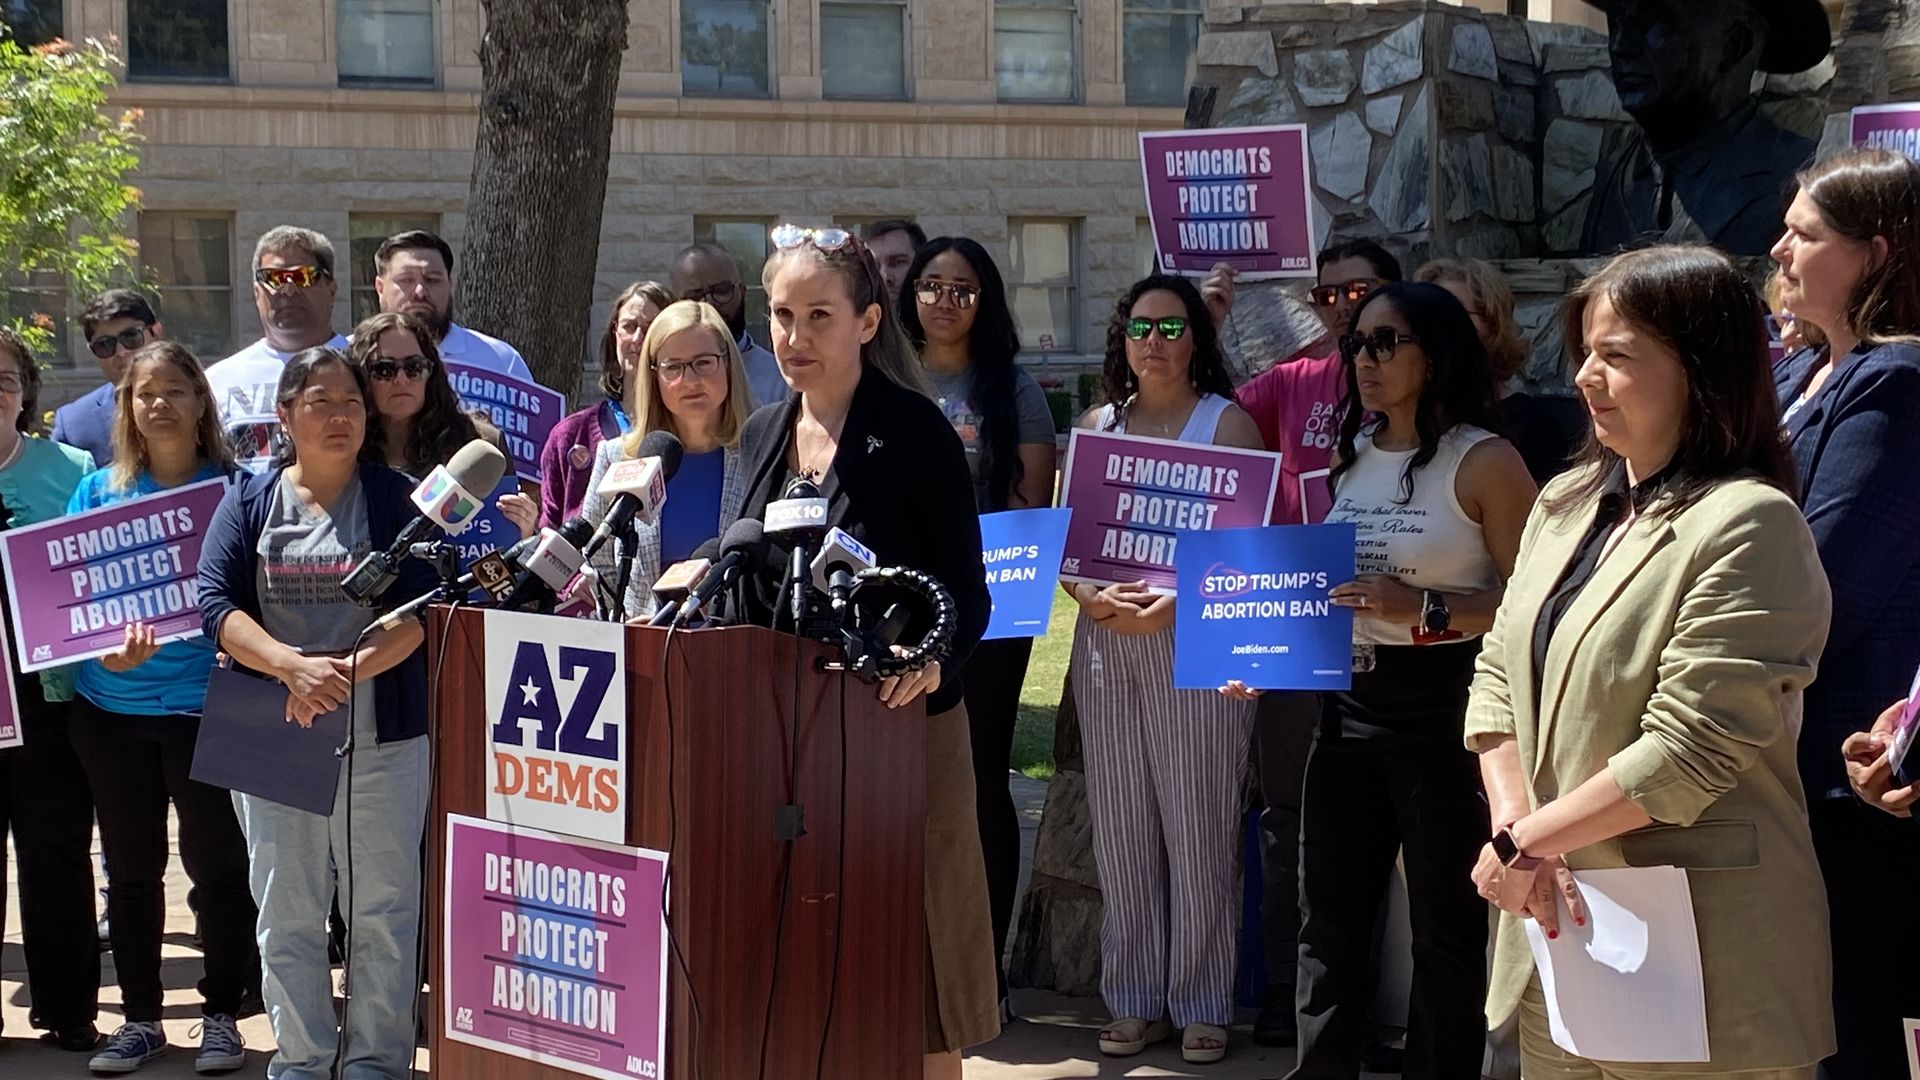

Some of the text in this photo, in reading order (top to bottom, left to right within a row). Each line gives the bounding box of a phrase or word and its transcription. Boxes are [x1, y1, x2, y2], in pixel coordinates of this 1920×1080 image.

[1165, 147, 1271, 177] DEMOCRATS
[1178, 184, 1258, 214] PROTECT
[1178, 221, 1269, 250] ABORTION
[1105, 454, 1239, 496] DEMOCRATS
[1115, 492, 1218, 531] PROTECT
[46, 506, 194, 566] DEMOCRATS
[1101, 529, 1177, 567] ABORT
[71, 545, 182, 598] PROTECT
[482, 561, 500, 582] abc
[1000, 567, 1036, 582] BAN
[1205, 572, 1328, 592] STOP TRUMP'S
[70, 578, 200, 635] ABORTION
[1202, 600, 1329, 620] ABORTION BAN
[1231, 644, 1289, 654] JoeBiden.com
[493, 640, 618, 761] AZ
[494, 751, 618, 814] DEMS
[485, 853, 626, 918] DEMOCRATS
[501, 910, 608, 974] PROTECT
[456, 1006, 473, 1024] AZ
[492, 965, 616, 1035] ABORTION
[626, 1055, 656, 1078] ADLCC
